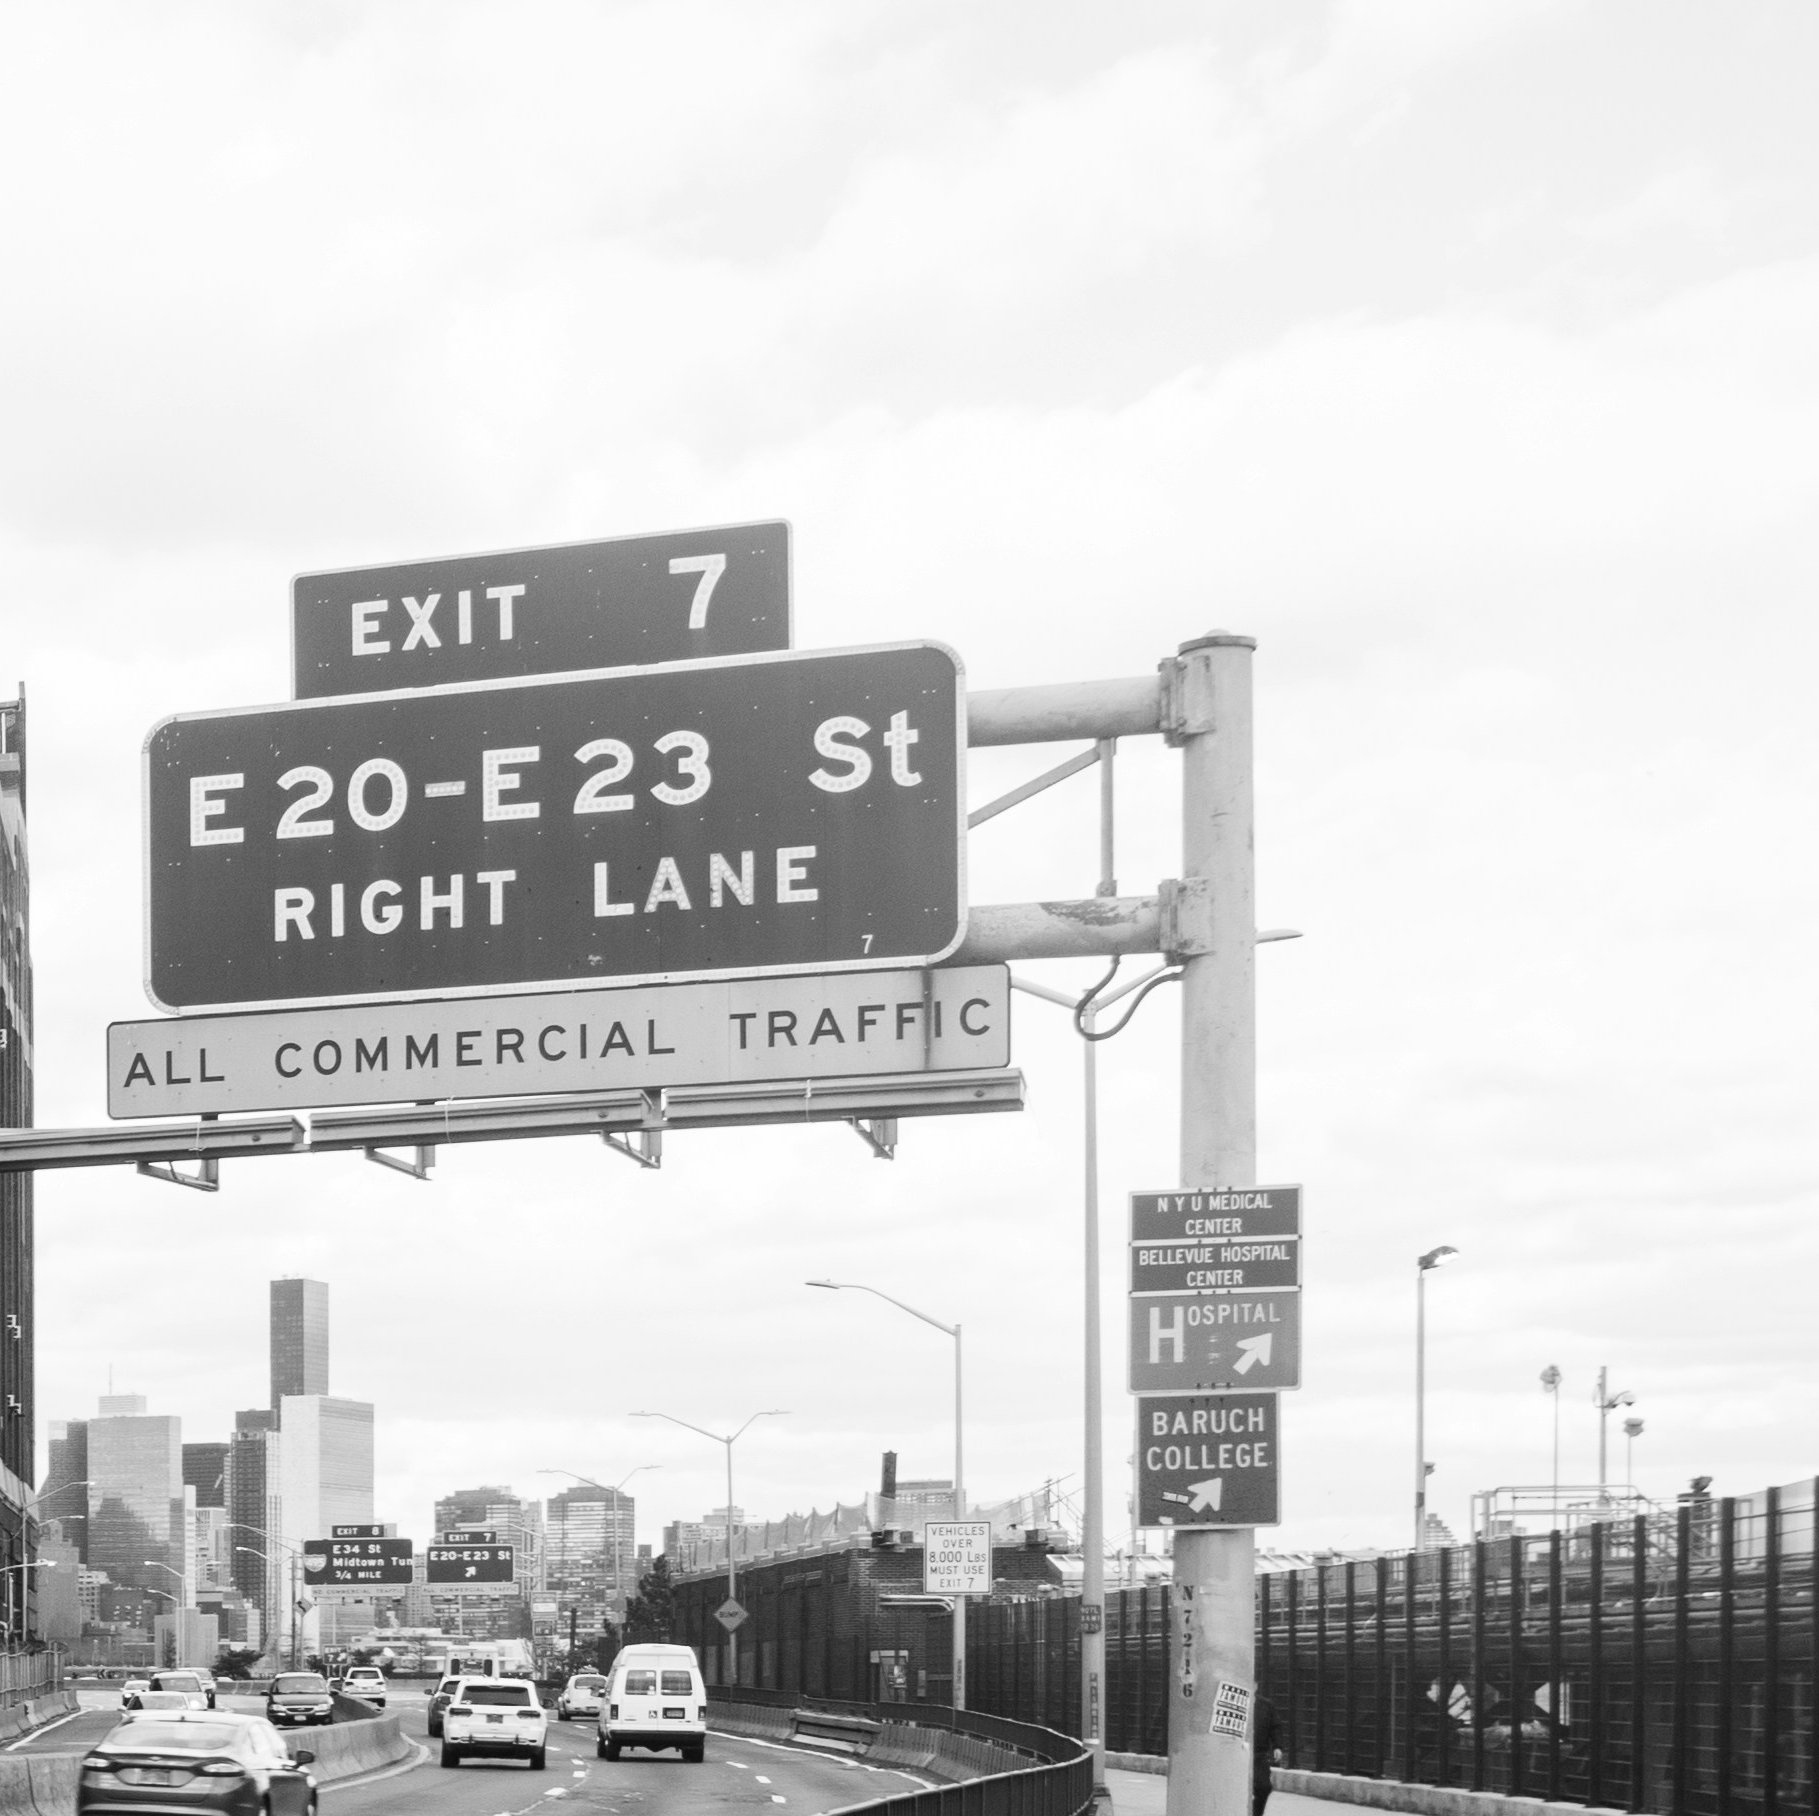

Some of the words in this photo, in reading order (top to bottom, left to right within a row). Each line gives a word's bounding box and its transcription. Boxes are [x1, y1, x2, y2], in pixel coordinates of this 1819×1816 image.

[352, 584, 526, 657] EXIT
[669, 553, 727, 629] 7
[807, 709, 923, 794] St
[275, 869, 517, 942] RIGHT
[594, 845, 819, 918] LANE
[123, 1046, 226, 1089] ALL
[275, 1018, 676, 1080] COMMERCIAL
[728, 997, 993, 1052] TRAFFIC
[1209, 1193, 1273, 1211] MEDICAL
[1185, 1217, 1243, 1235] CENTER
[1138, 1247, 1214, 1266] BELLEVUE
[1220, 1244, 1290, 1262] HOSPITAL
[1186, 1269, 1244, 1286] CENTER
[1149, 1303, 1281, 1364] HOSPITAL
[1152, 1407, 1265, 1436] BARUCH
[1146, 1443, 1268, 1471] COLLEGE
[336, 1527, 358, 1536] EXIT
[371, 1526, 380, 1536] 8
[448, 1533, 470, 1542] EXIT
[483, 1532, 491, 1542] 7
[931, 1526, 985, 1536] VEHICLES
[367, 1543, 381, 1553] St
[942, 1538, 973, 1548] OVER
[332, 1557, 385, 1567] Midtown
[497, 1550, 511, 1560] St
[335, 1570, 352, 1580] 3/4
[357, 1570, 382, 1579] MILE
[930, 1565, 958, 1575] MUST
[963, 1565, 985, 1575] USE
[939, 1578, 961, 1588] EXIT
[967, 1577, 974, 1588] 7
